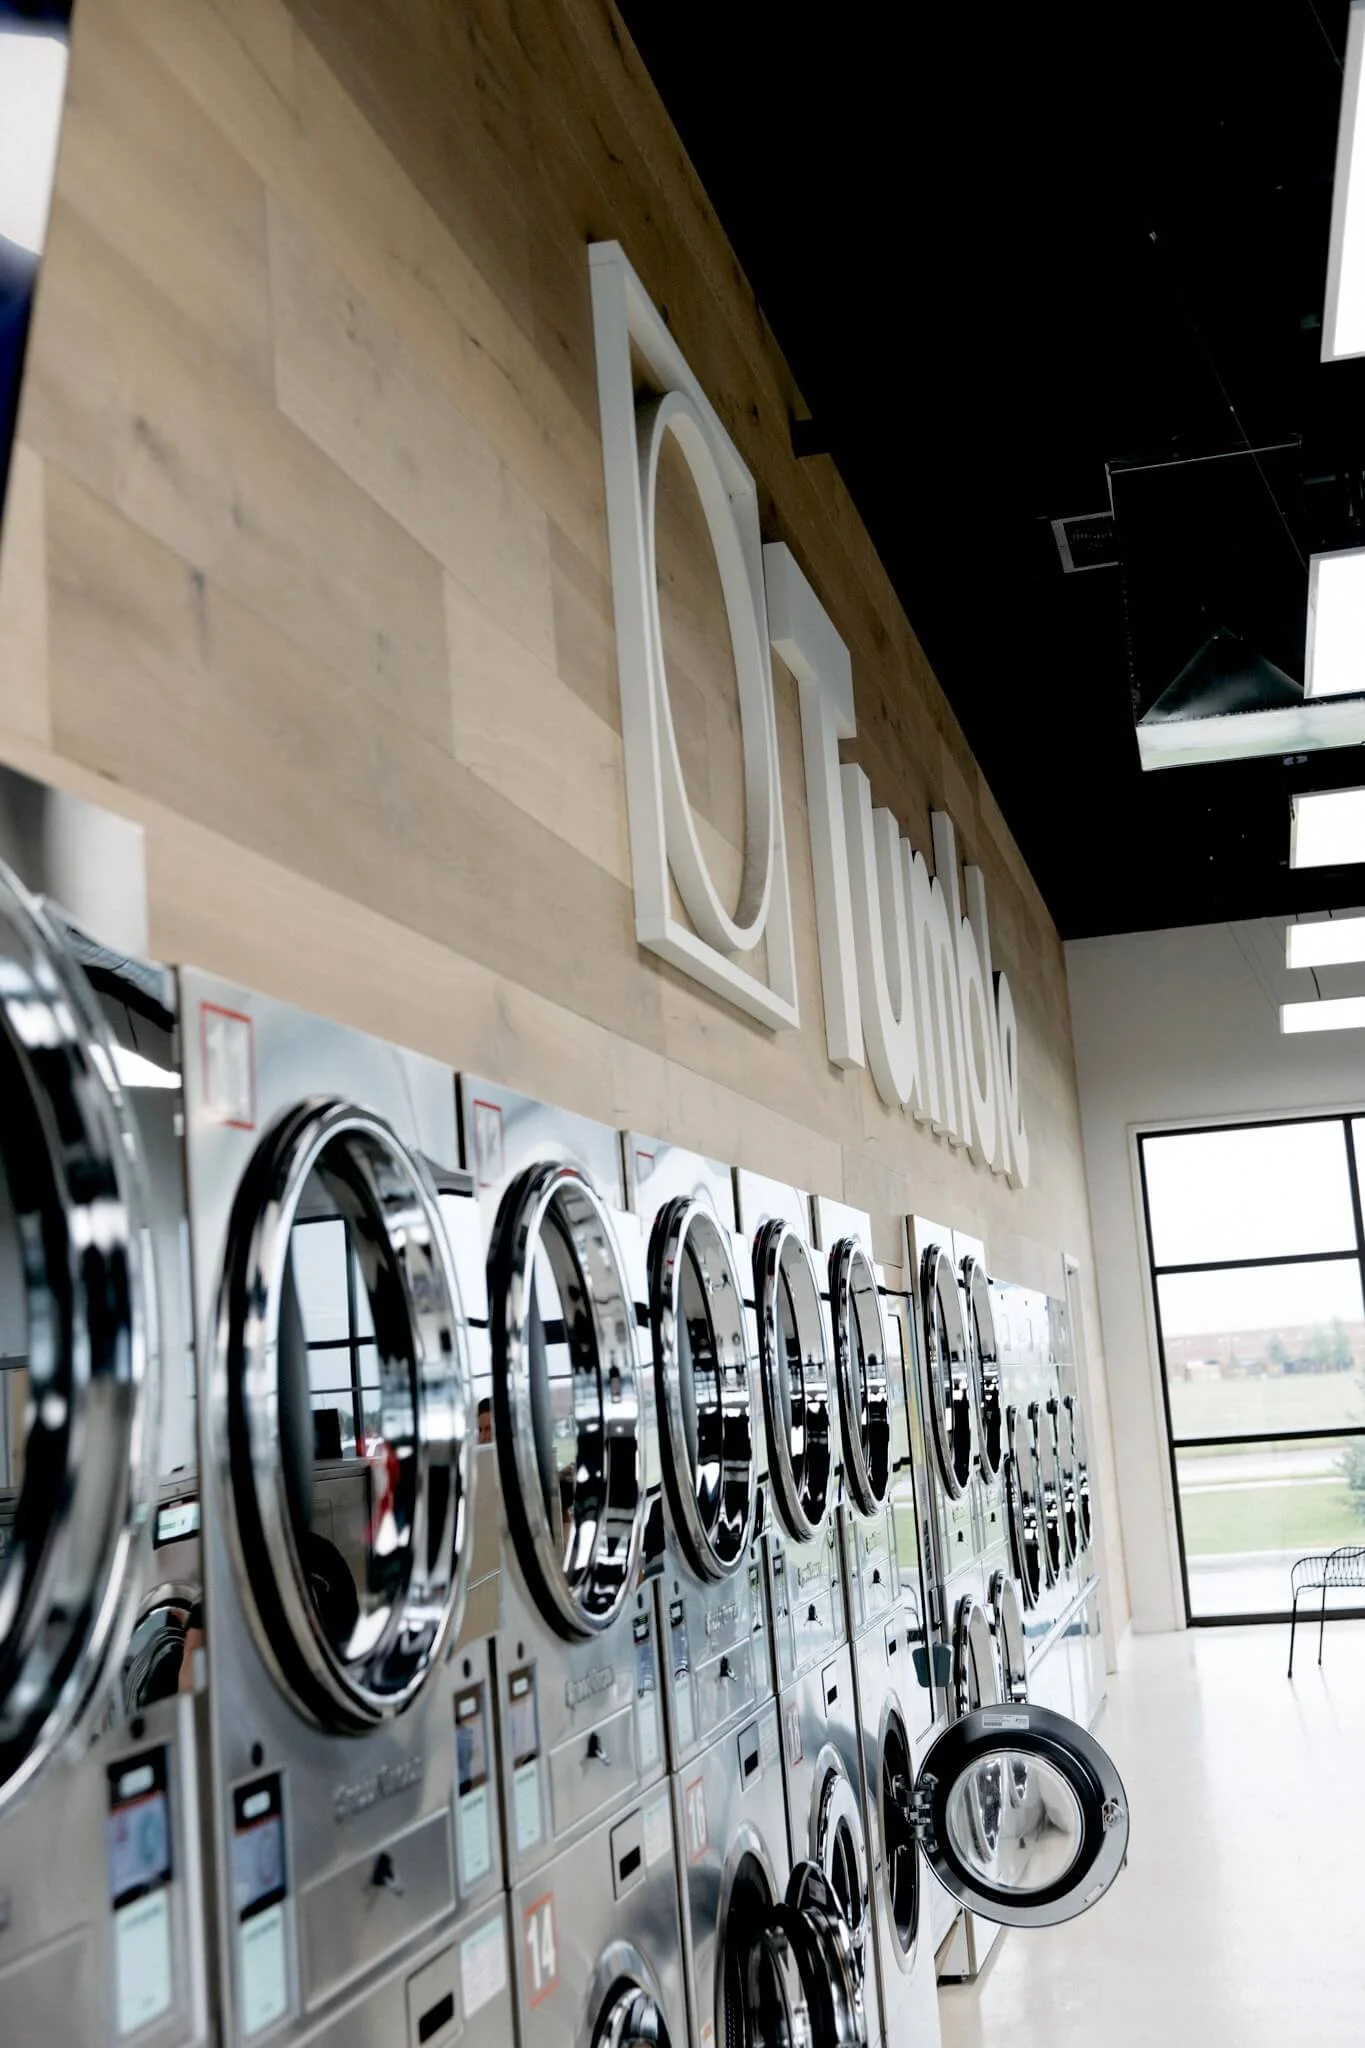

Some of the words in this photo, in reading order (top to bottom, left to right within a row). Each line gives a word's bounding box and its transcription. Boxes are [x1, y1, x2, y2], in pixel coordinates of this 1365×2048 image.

[764, 542, 1029, 1189] Tumble
[687, 1786, 708, 1850] 16
[526, 1902, 556, 1990] 14
